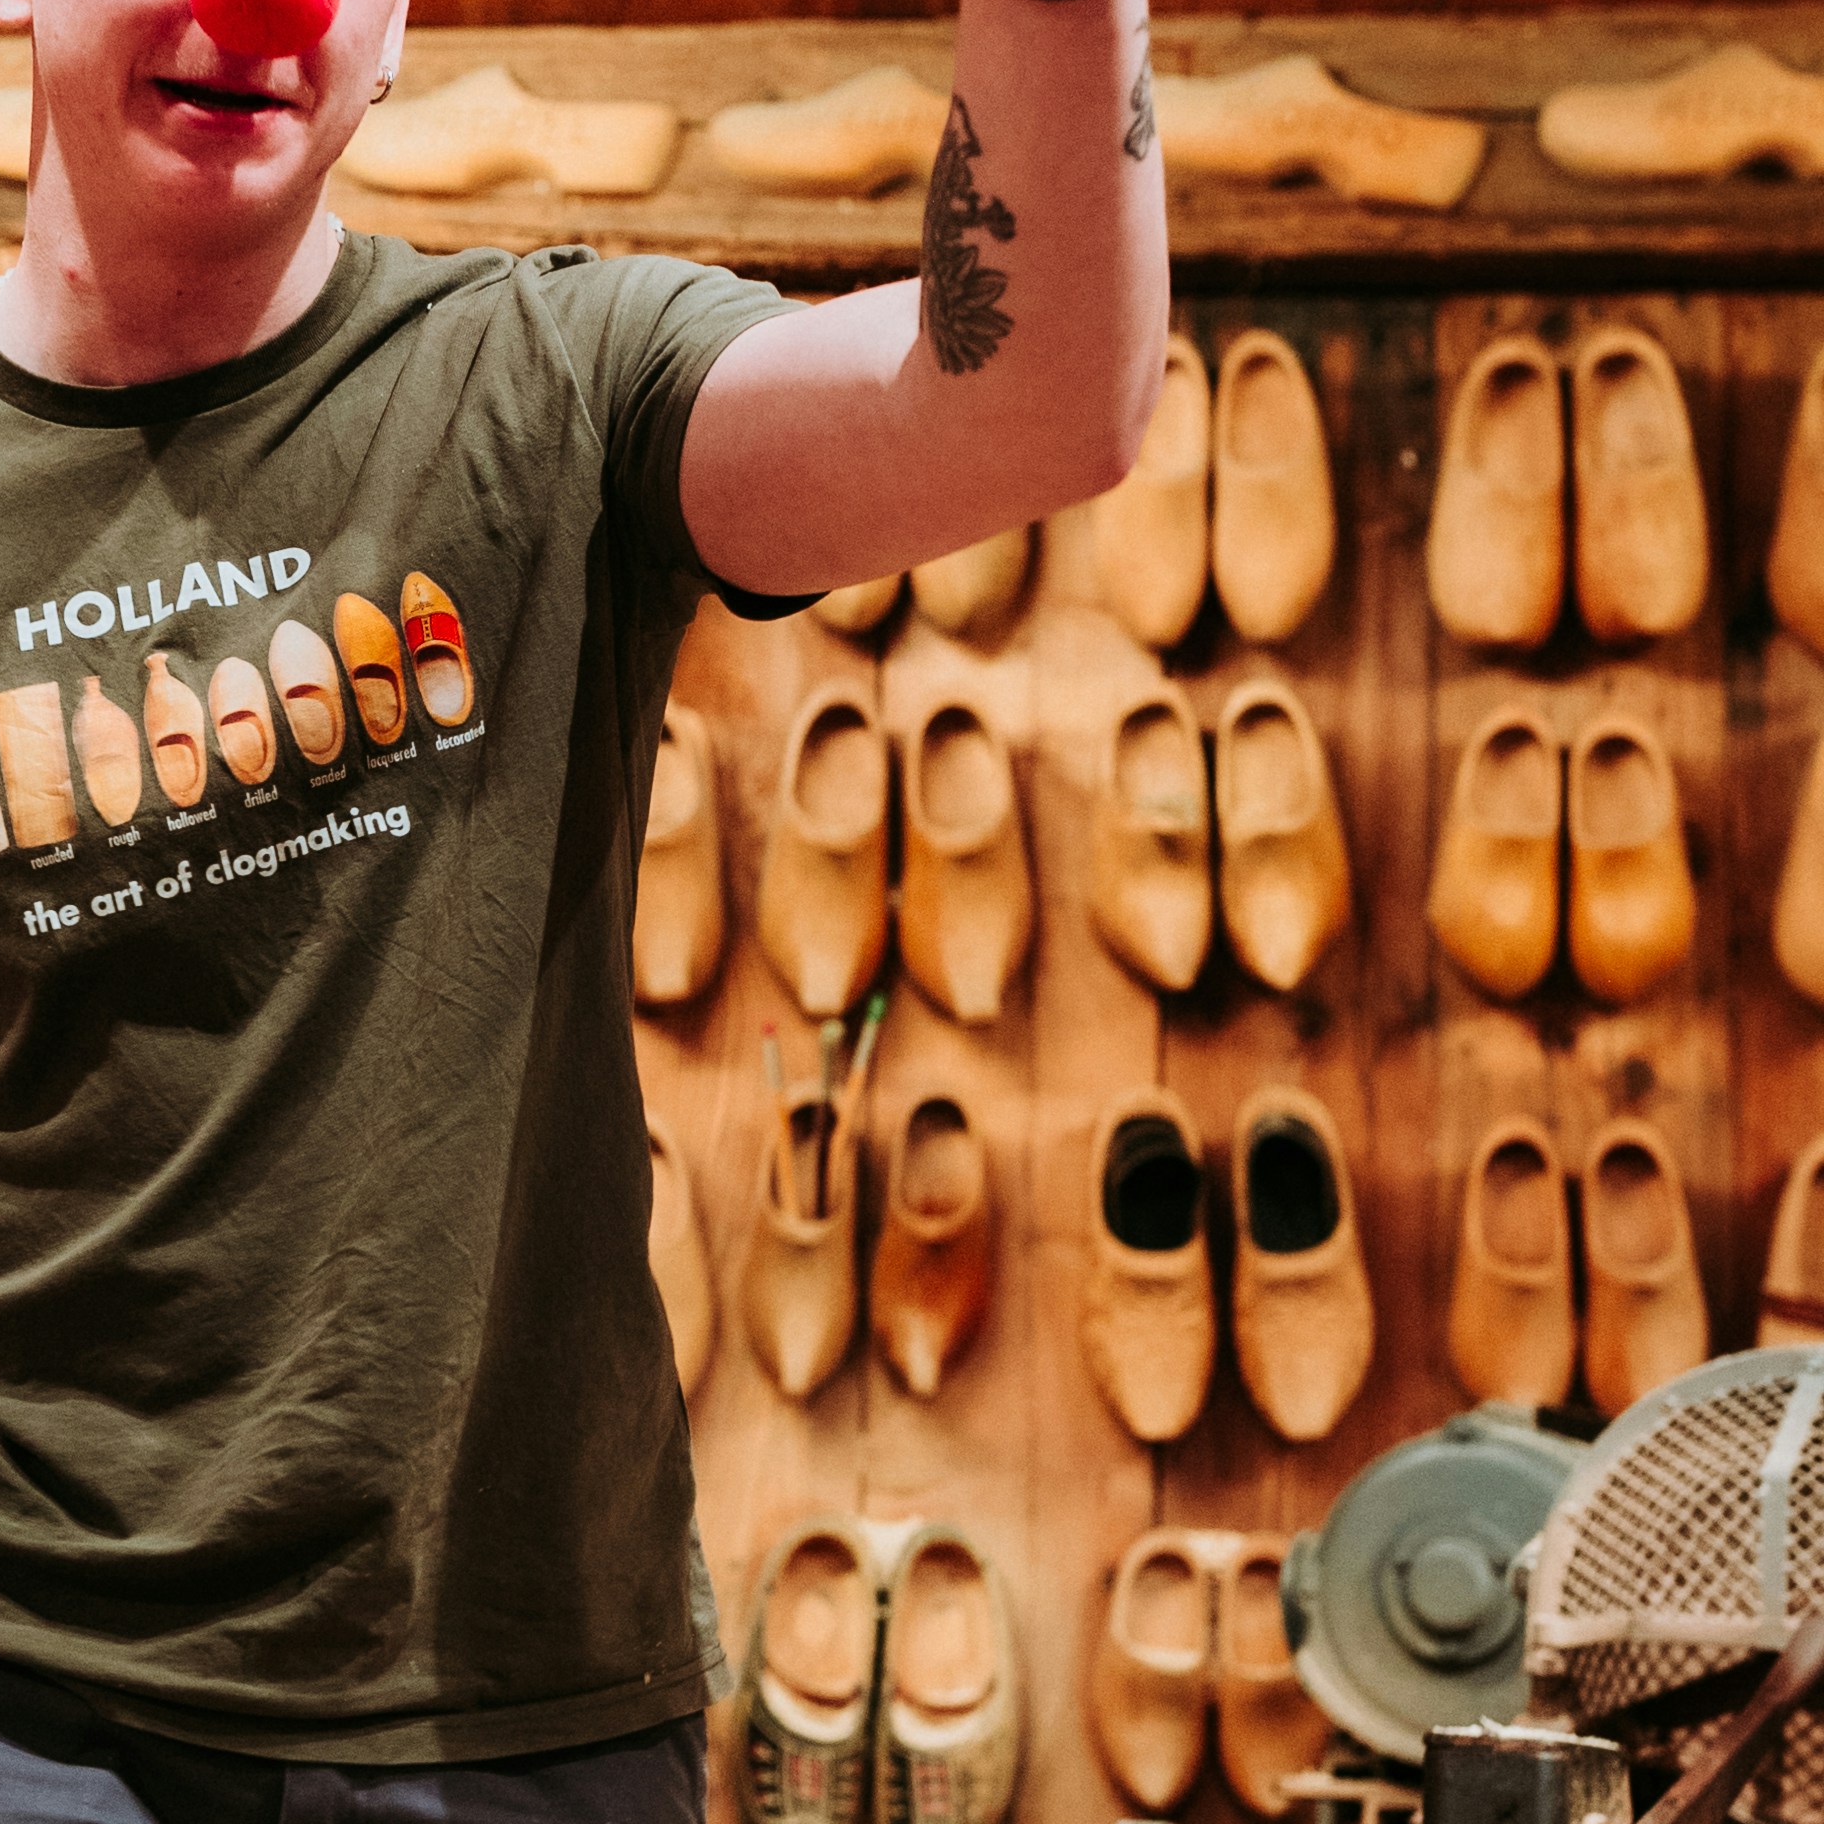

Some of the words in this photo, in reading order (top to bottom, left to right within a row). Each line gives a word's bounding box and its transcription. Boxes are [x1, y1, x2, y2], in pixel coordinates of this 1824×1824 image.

[14, 547, 312, 651] HOLLAND
[30, 843, 75, 869] rounded
[108, 826, 141, 848] rough
[166, 803, 217, 831] hollowed
[244, 784, 278, 809] drilled
[309, 764, 347, 788] sanded
[366, 742, 418, 770] lacquered
[435, 720, 486, 751] decorated
[23, 901, 80, 936] the
[90, 880, 144, 917] art
[155, 860, 192, 899] of
[205, 805, 411, 884] clogmaking
